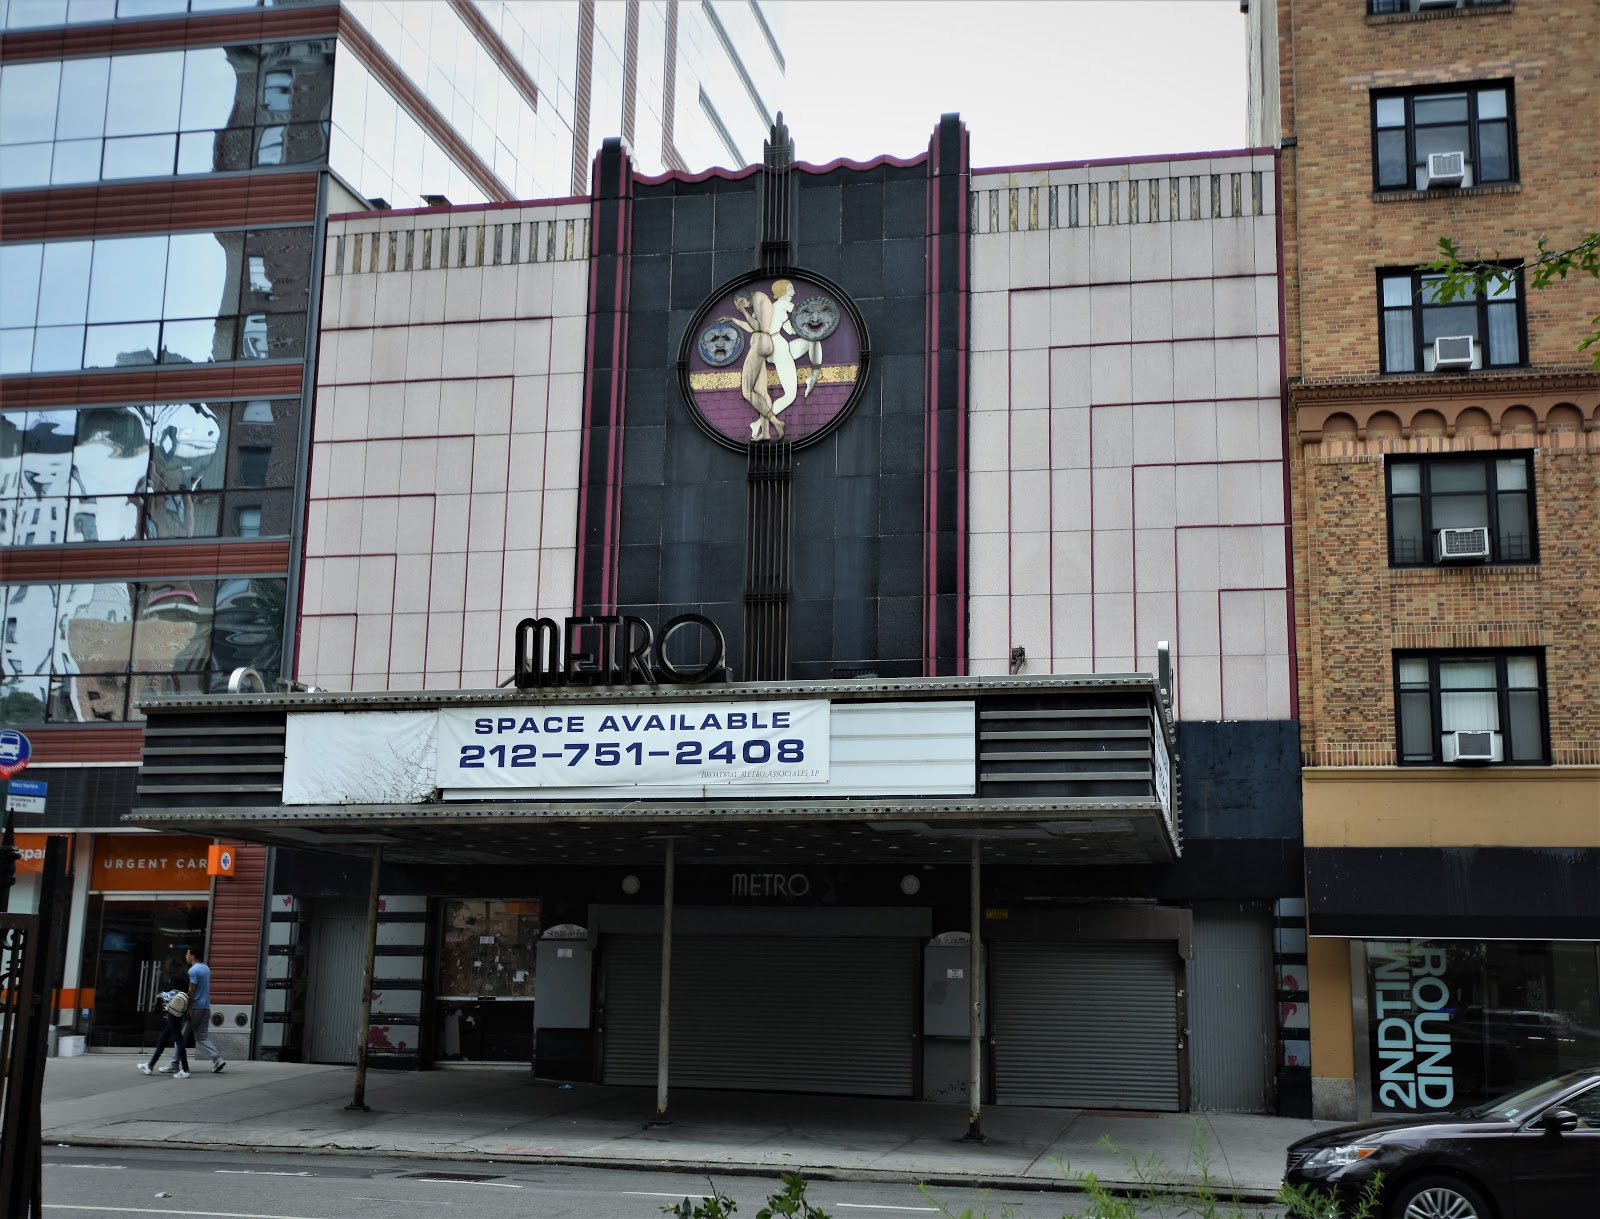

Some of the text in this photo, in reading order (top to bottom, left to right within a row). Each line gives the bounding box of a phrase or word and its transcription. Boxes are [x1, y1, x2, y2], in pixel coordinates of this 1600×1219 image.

[515, 613, 726, 687] METRO
[475, 711, 791, 734] SPACE AVAILABLE
[459, 738, 805, 769] 212-751-2408
[104, 858, 208, 869] URGENT CAR
[731, 873, 809, 896] METRO
